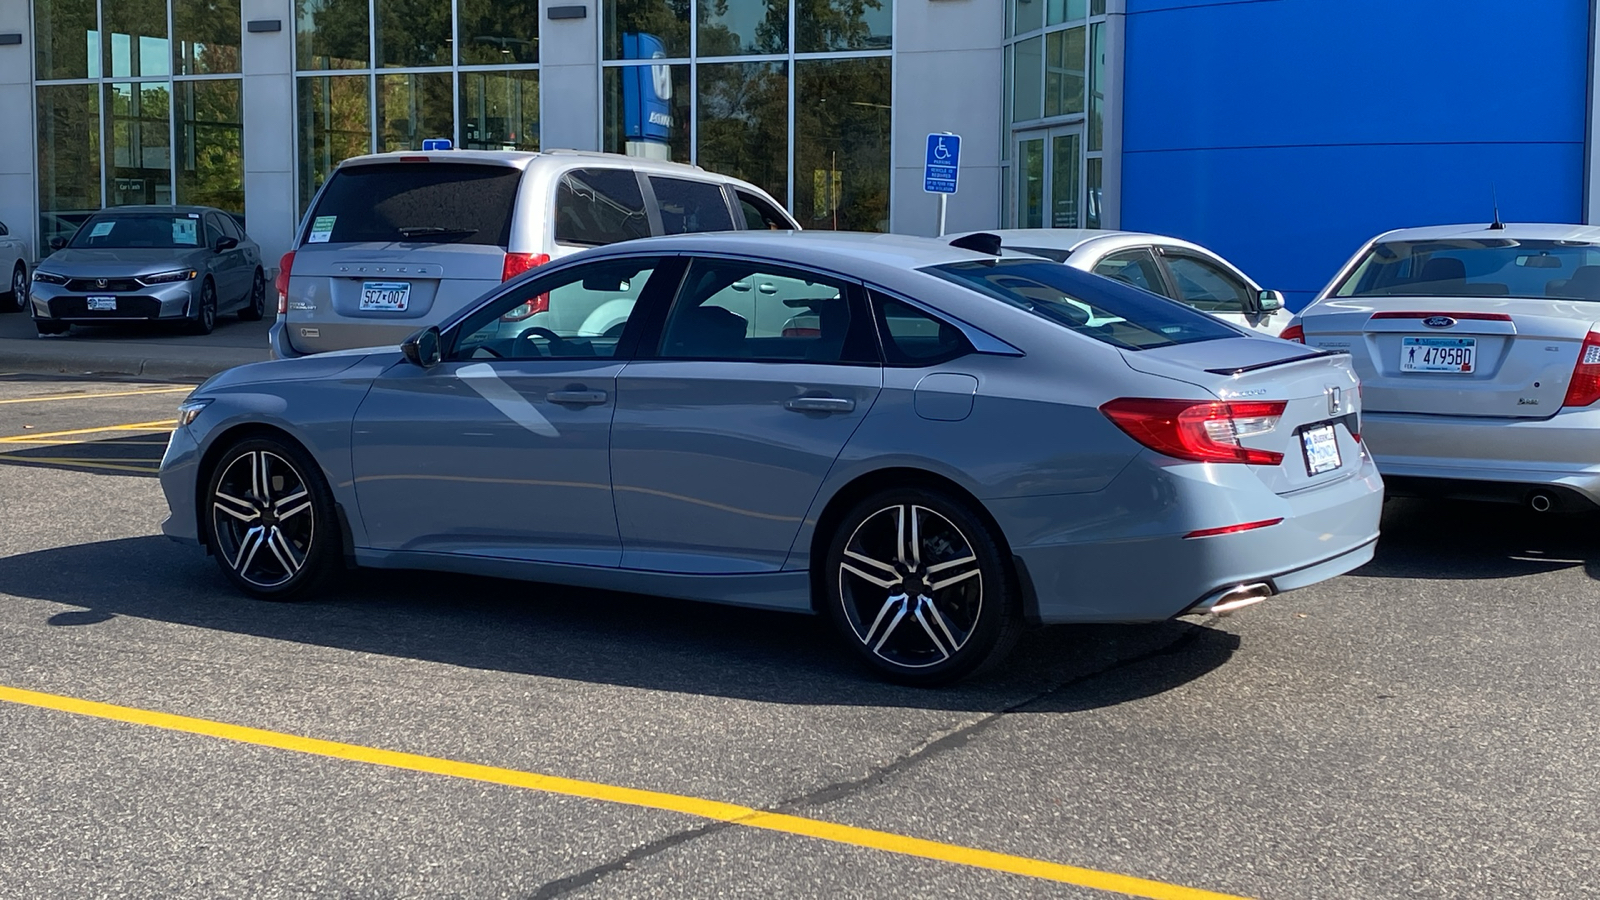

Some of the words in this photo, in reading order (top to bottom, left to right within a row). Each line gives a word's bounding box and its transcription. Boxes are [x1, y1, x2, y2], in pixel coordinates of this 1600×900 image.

[364, 290, 382, 304] SCZ
[387, 290, 406, 304] 007
[1429, 317, 1449, 325] Ford
[1423, 347, 1472, 365] 4795BD
[1315, 445, 1336, 459] HONDA
